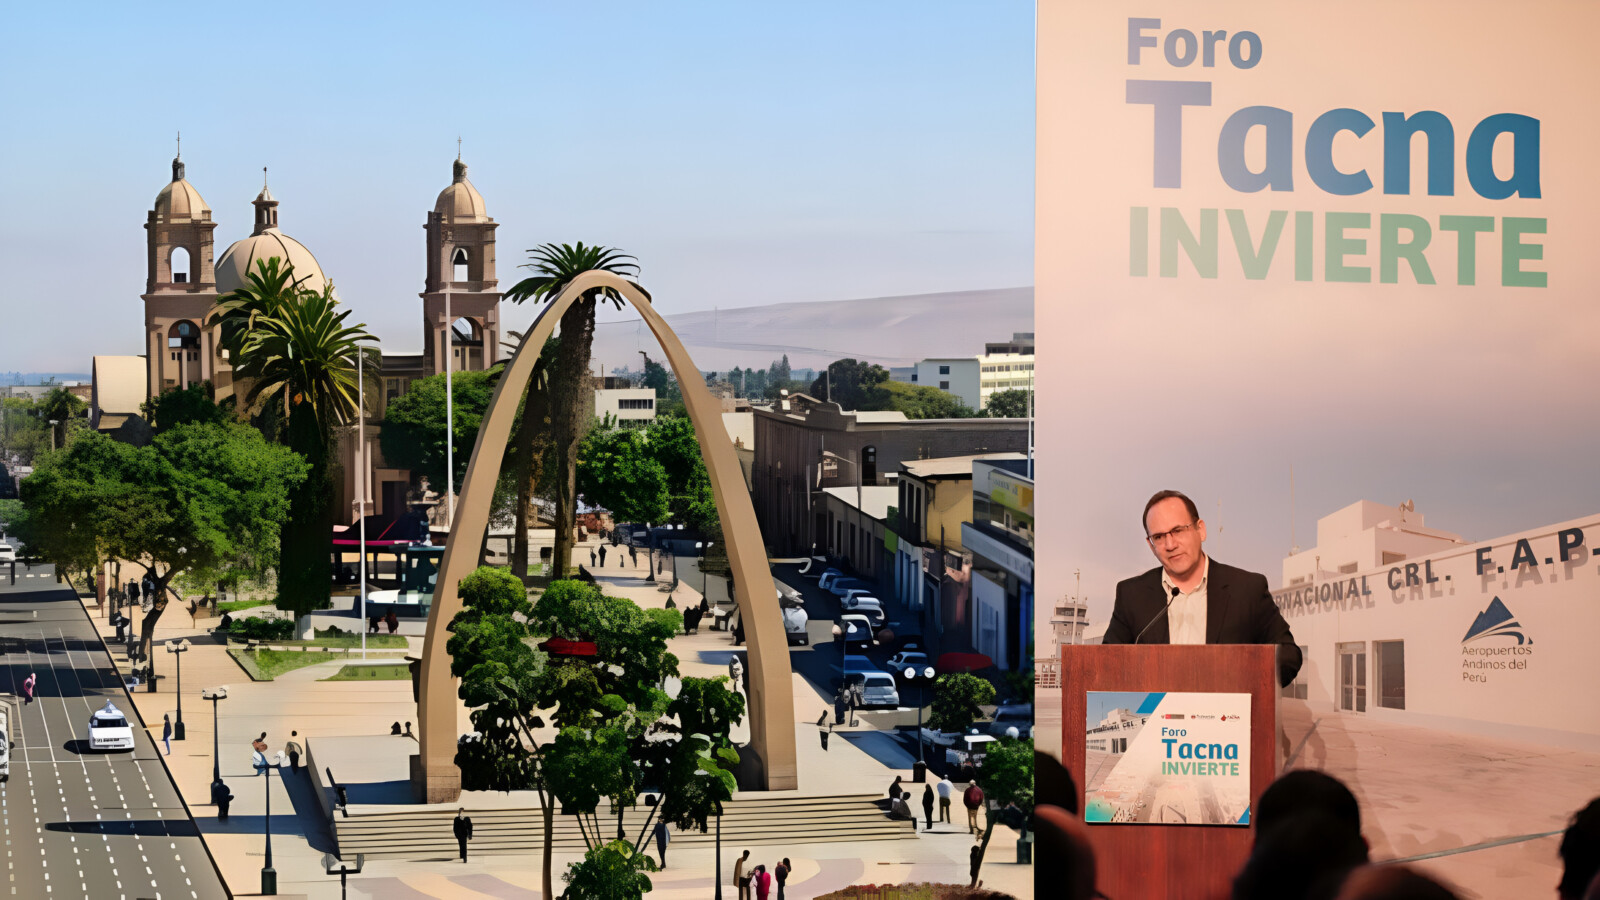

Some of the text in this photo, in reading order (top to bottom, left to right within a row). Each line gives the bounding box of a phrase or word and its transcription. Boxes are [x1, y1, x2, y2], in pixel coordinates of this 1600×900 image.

[1127, 17, 1263, 70] Foro
[1125, 79, 1542, 201] Tacna
[1129, 206, 1548, 288] INVIERTE
[1273, 575, 1372, 609] RNACIONAL
[1387, 559, 1451, 591] CRL.
[1461, 646, 1532, 657] Aeropuertos
[1462, 659, 1527, 670] Andinos del
[1462, 671, 1487, 683] Perú
[1161, 727, 1187, 737] Foro
[1161, 738, 1238, 760] Tacna
[1161, 761, 1240, 776] INVIERTE
